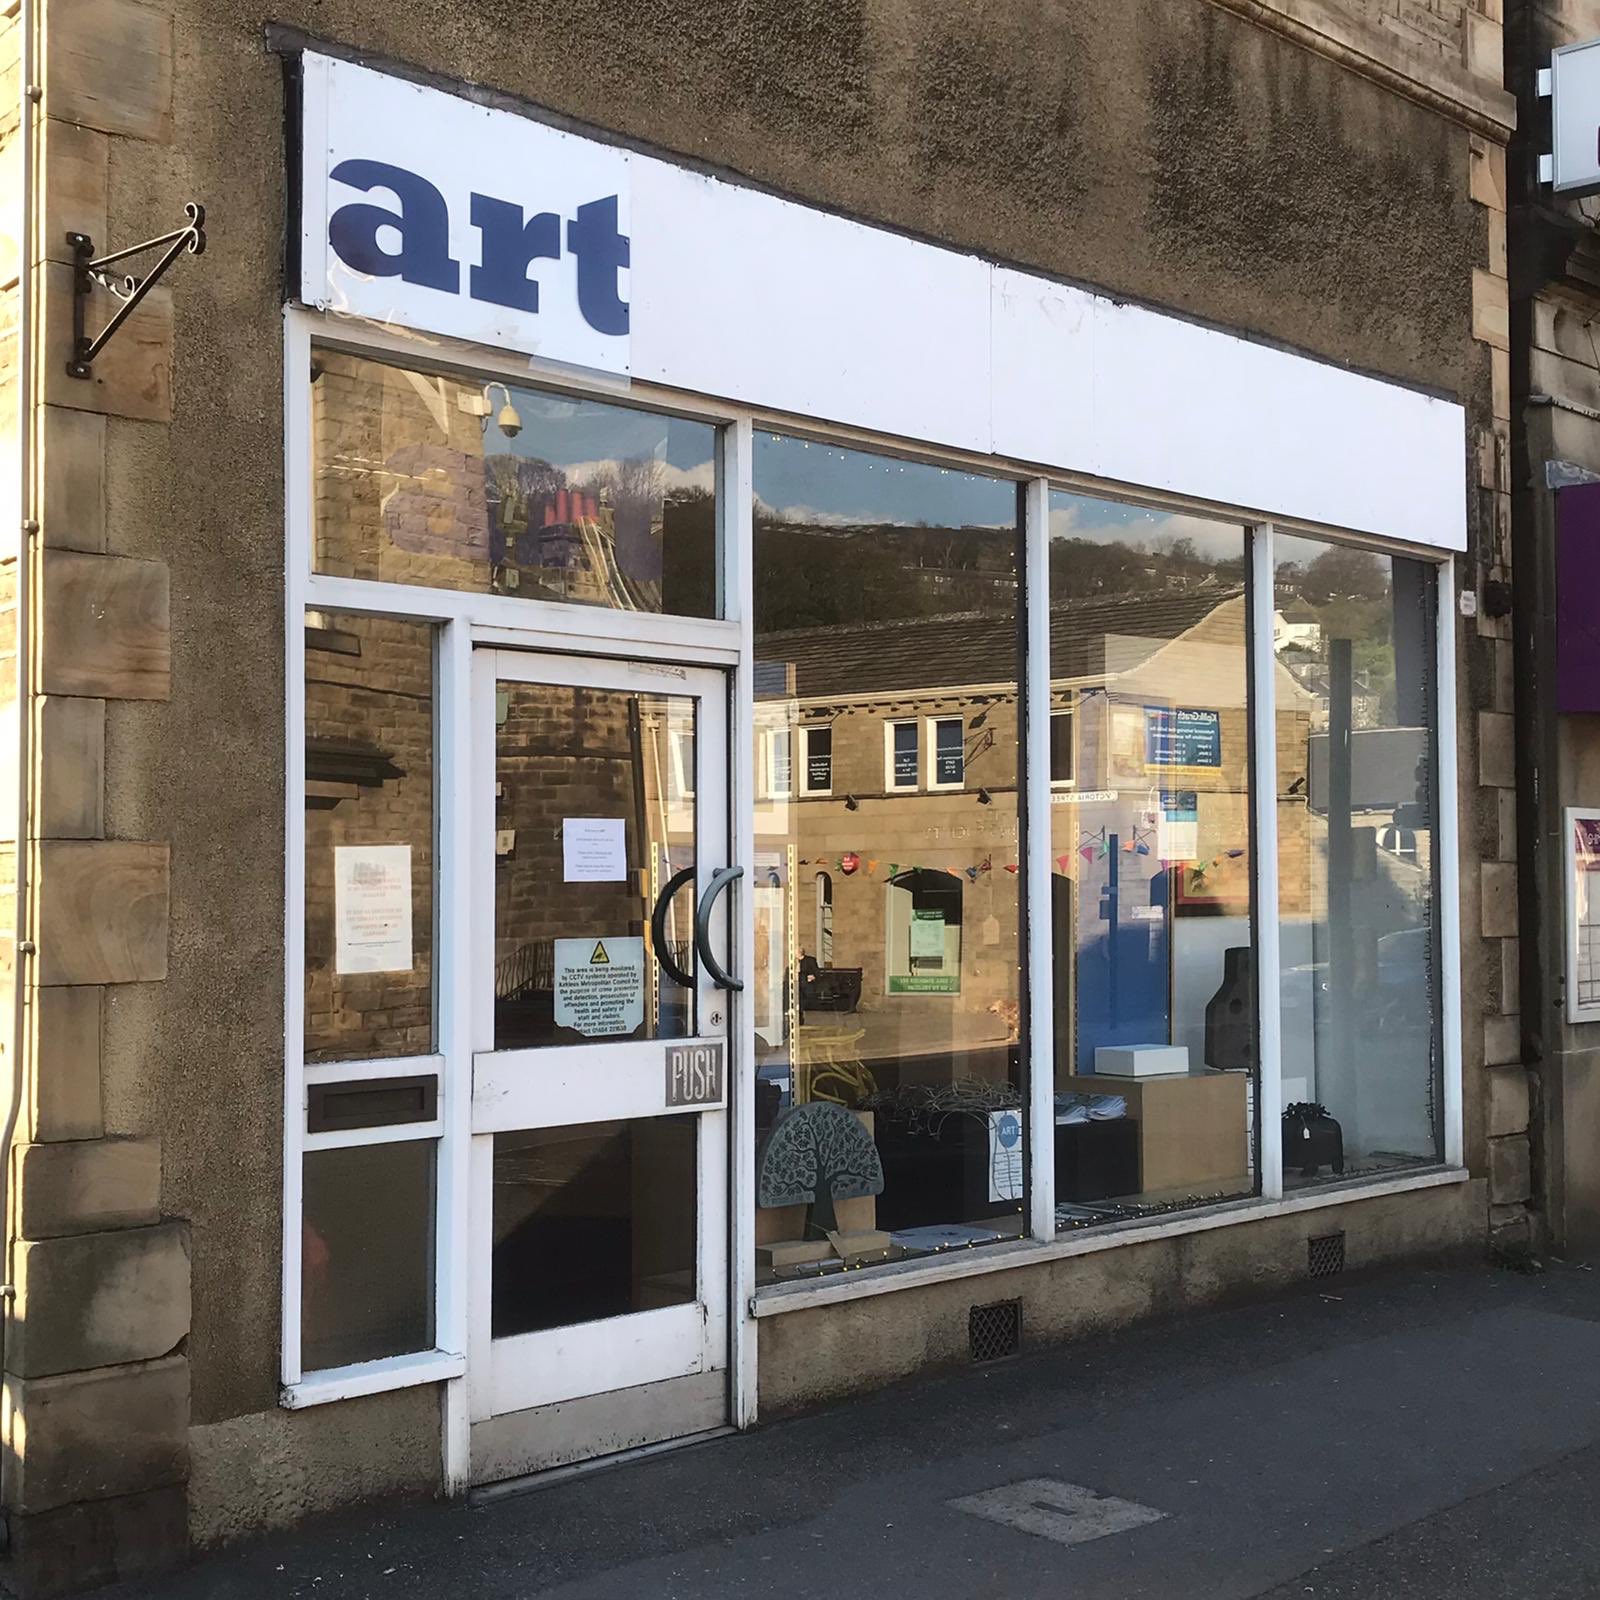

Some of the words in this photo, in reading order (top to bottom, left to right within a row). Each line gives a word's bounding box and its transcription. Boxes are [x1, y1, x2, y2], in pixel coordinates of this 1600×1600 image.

[329, 159, 630, 336] art
[672, 1049, 716, 1101] PUSH
[1001, 1126, 1015, 1136] ART
